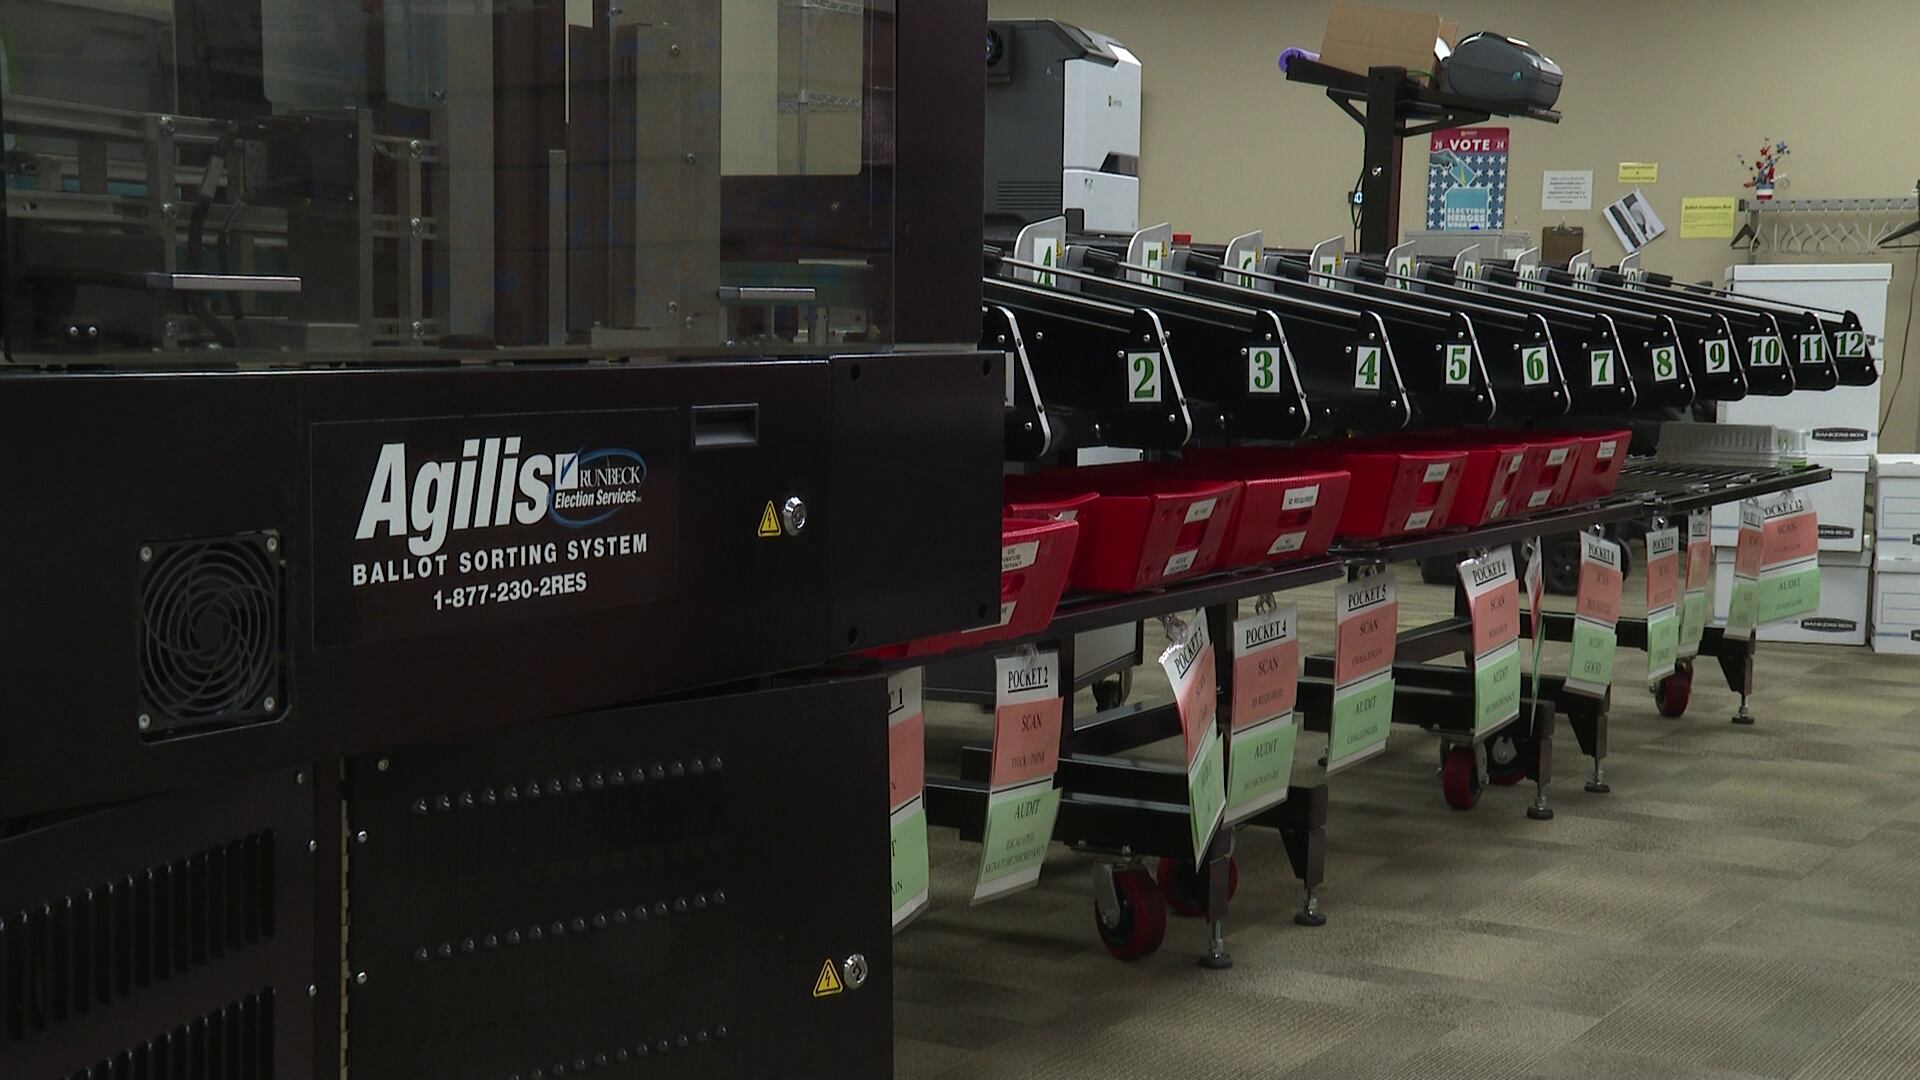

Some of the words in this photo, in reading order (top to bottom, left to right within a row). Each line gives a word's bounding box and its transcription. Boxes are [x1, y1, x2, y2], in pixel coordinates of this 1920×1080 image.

[1449, 139, 1491, 151] VOTE
[1447, 214, 1486, 222] HEROES
[1753, 338, 1780, 364] 10
[1802, 337, 1823, 361] 11
[1838, 332, 1864, 356] 12
[1358, 350, 1377, 385] 4
[1449, 348, 1467, 381] 5
[1526, 349, 1544, 381] 6
[1594, 353, 1610, 382] 7
[1656, 349, 1673, 376] 8
[1709, 343, 1725, 370] 9
[1133, 357, 1156, 398] 2
[1254, 350, 1273, 389] 3
[580, 466, 641, 488] RUNBECK
[354, 436, 553, 556] Agilis
[555, 491, 595, 509] Election
[596, 488, 637, 505] Services
[1764, 499, 1795, 517] OCKET
[352, 555, 448, 586] BALLOT
[459, 542, 557, 574] SORTING
[567, 533, 648, 561] SYSTEM
[1472, 559, 1502, 583] POCKET
[433, 572, 588, 610] 1-877-230-2RES
[1348, 585, 1381, 608] POCKET
[1382, 584, 1386, 598] 5
[1777, 577, 1801, 591] AUDIT
[1246, 620, 1281, 645] POCKET
[1282, 618, 1287, 633] 4
[1359, 618, 1379, 636] SCAN
[1174, 631, 1200, 675] POCKET
[1258, 655, 1279, 675] SCAN
[1008, 667, 1043, 689] POCKET
[1044, 666, 1048, 684] 2
[1021, 712, 1043, 732] SCAN
[1254, 738, 1279, 760] AUDIT
[1014, 799, 1041, 820] AUDIT
